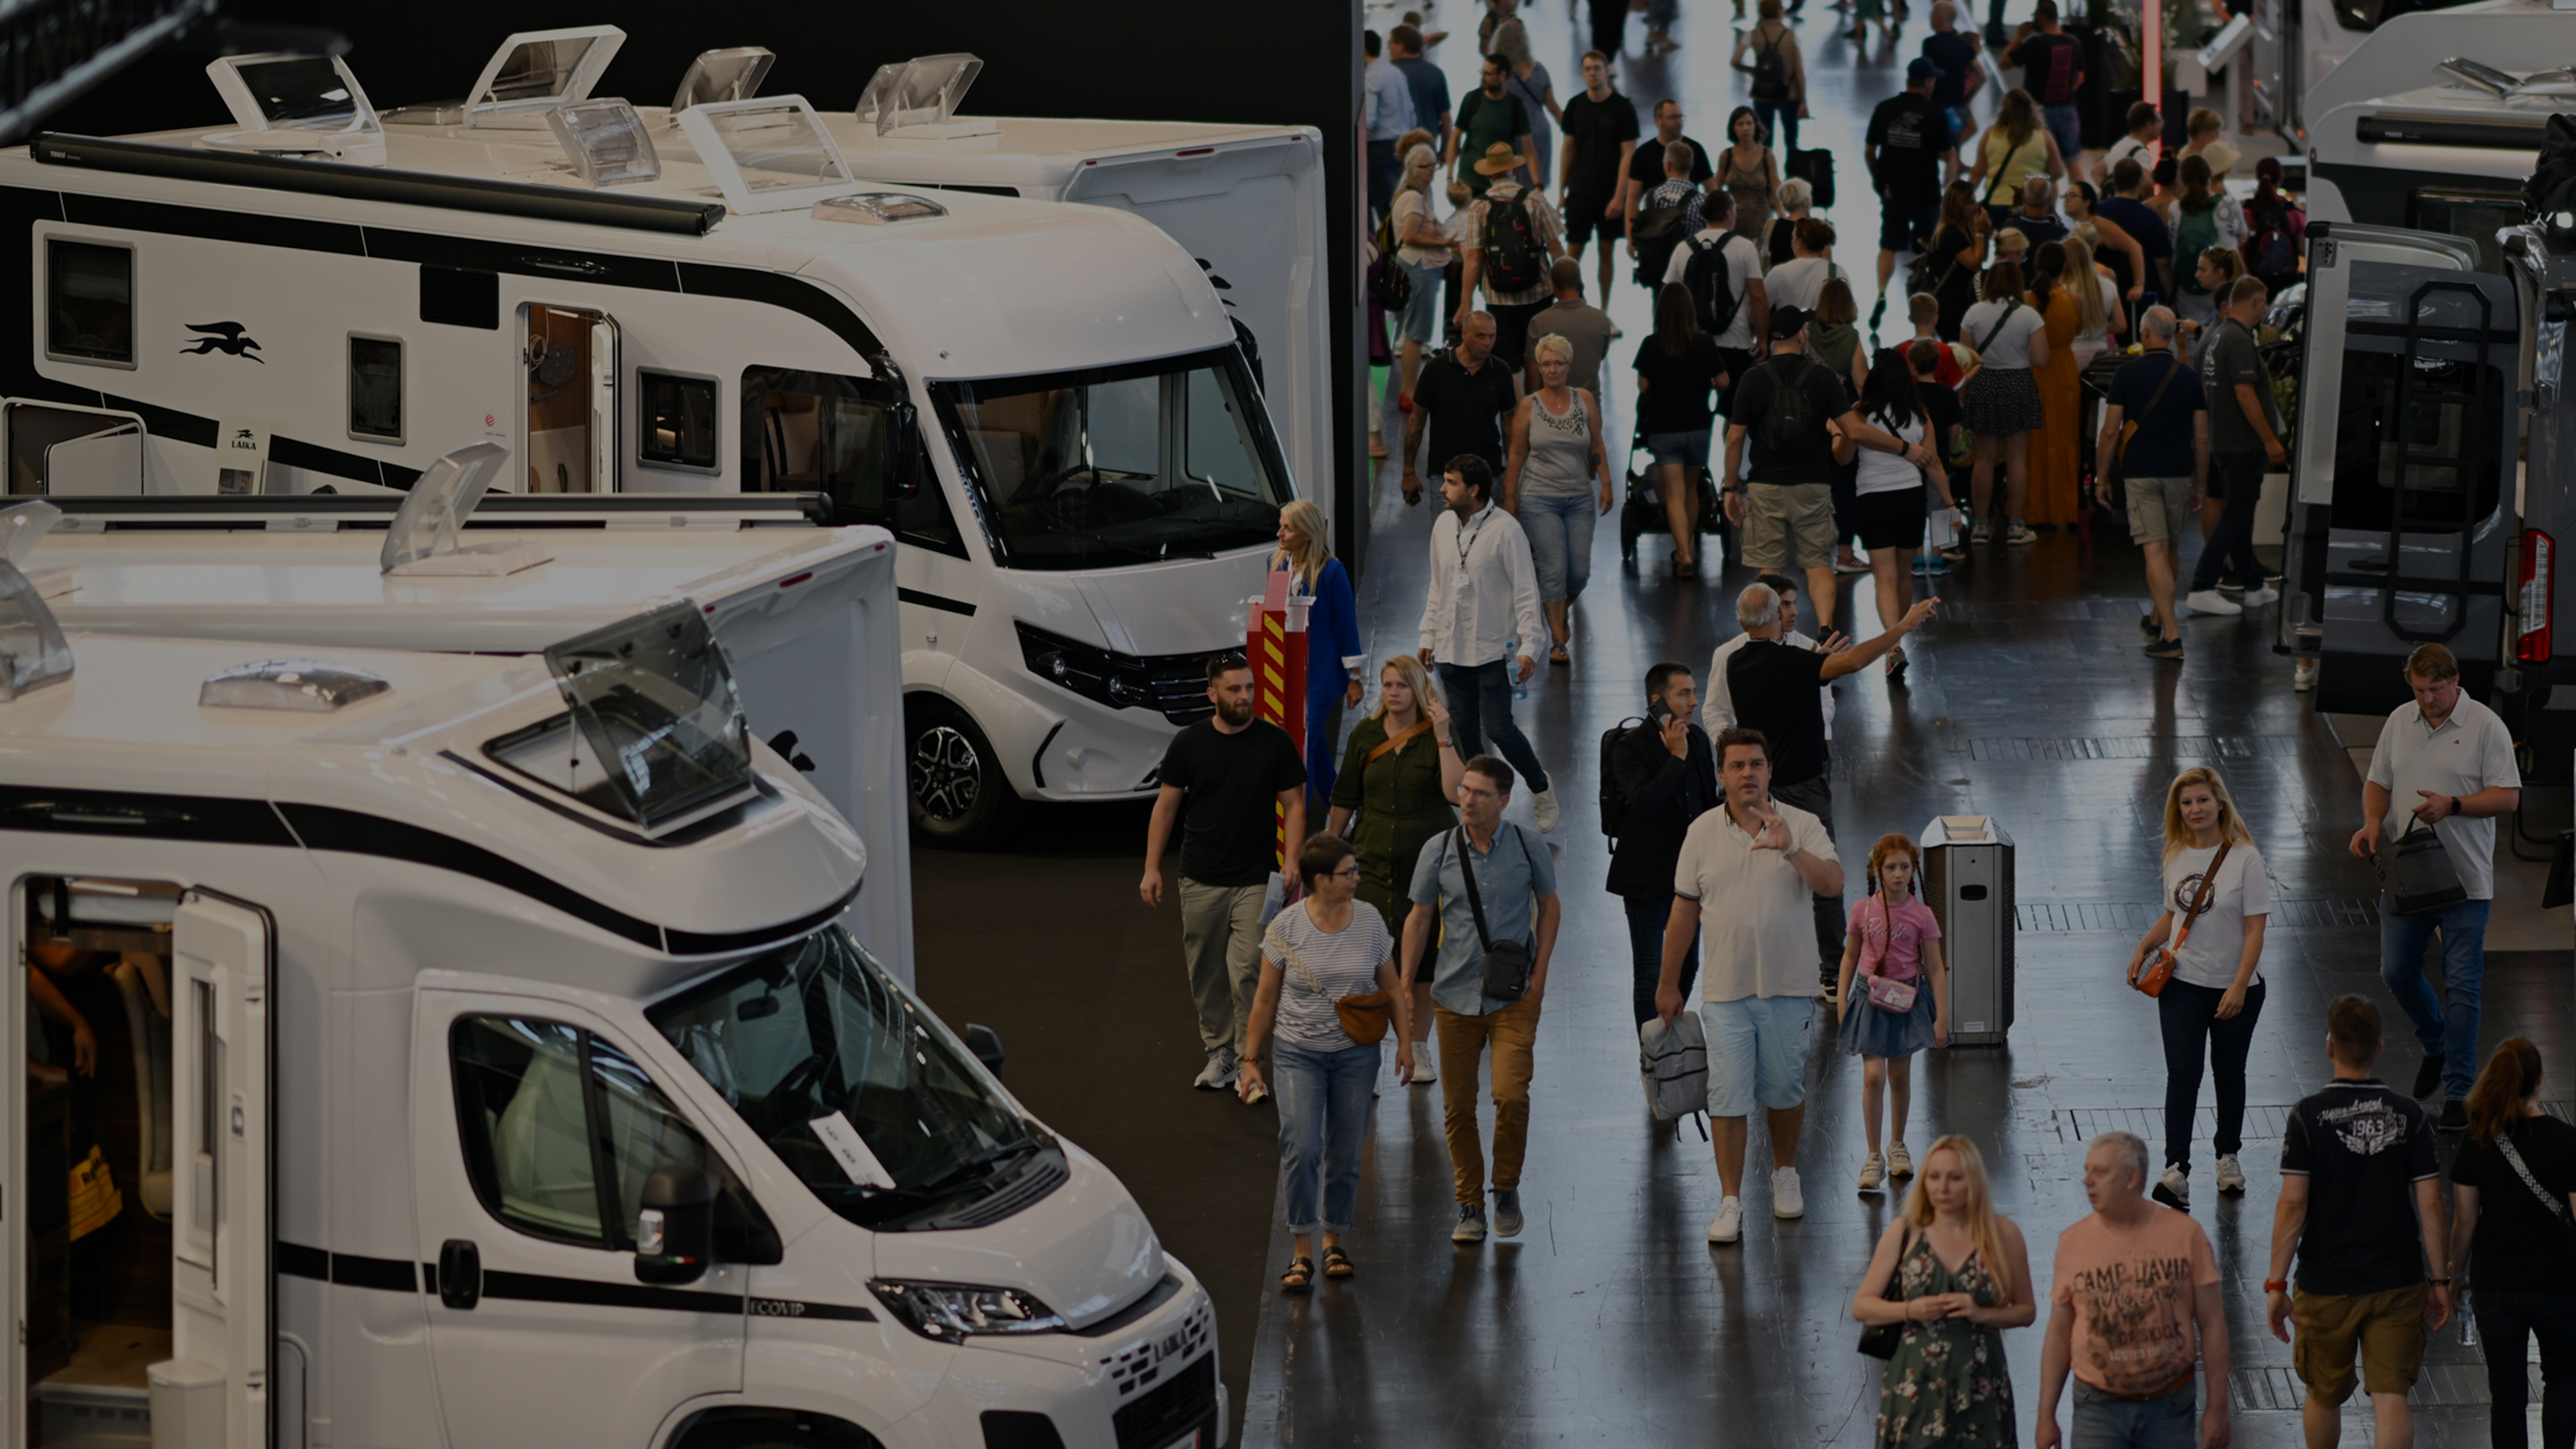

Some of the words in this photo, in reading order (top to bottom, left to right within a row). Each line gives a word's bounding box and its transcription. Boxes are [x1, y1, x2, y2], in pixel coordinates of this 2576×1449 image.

[231, 440, 256, 450] LAIKA
[1867, 916, 1911, 941] Babie
[2351, 1118, 2385, 1138] 1963
[2074, 1261, 2127, 1292] CAMP
[749, 1300, 805, 1316] ECOVIP
[1155, 1328, 1187, 1363] LAIKA
